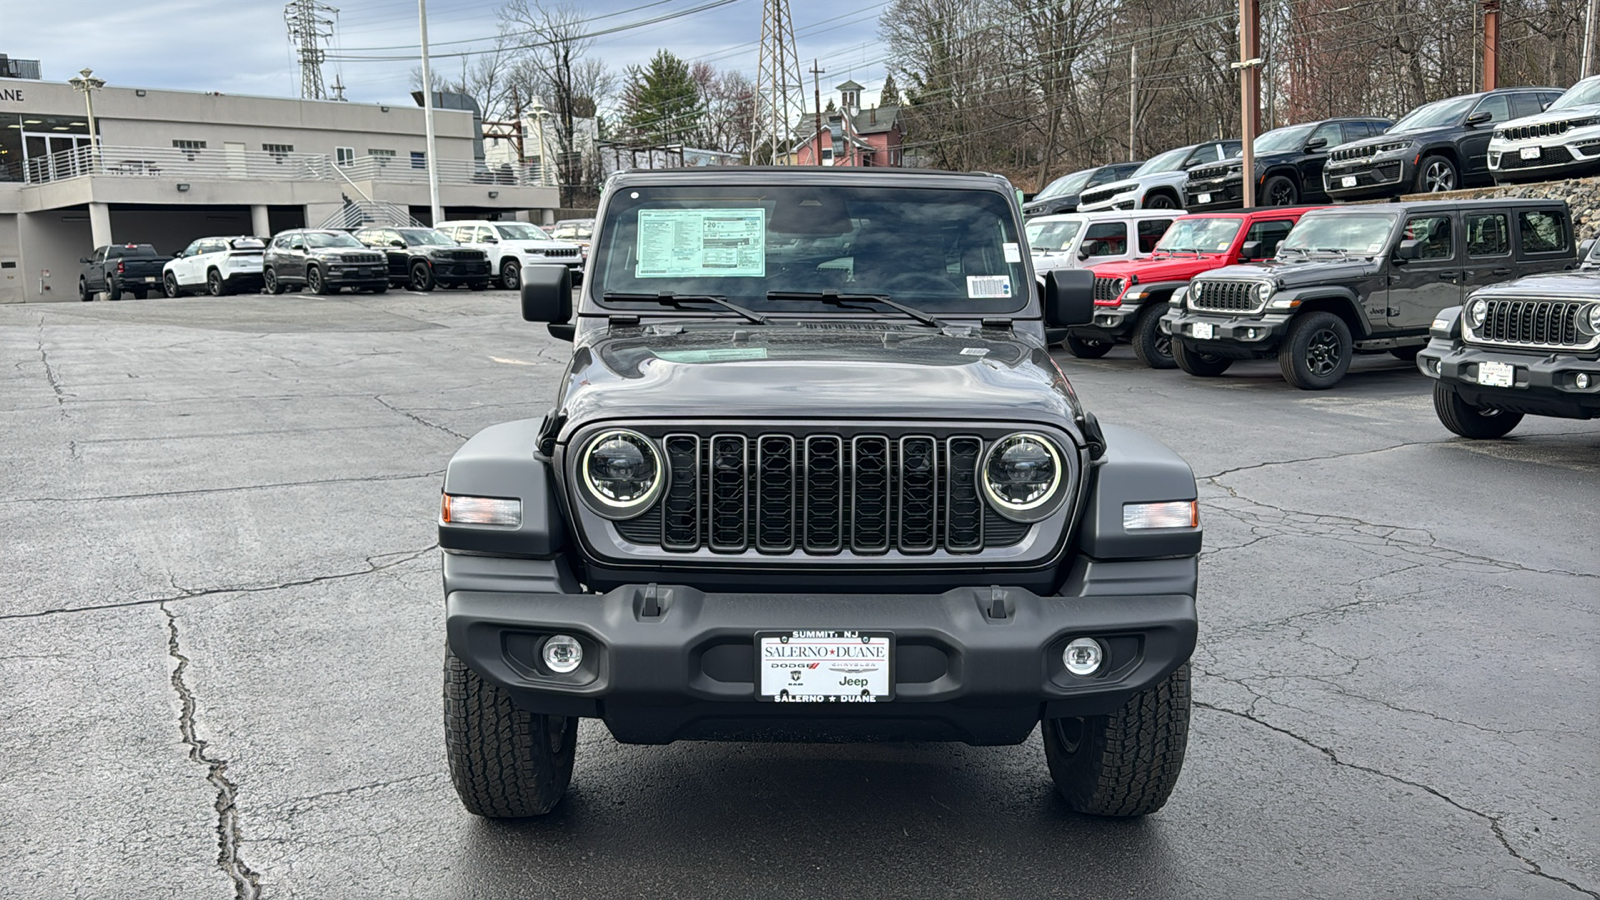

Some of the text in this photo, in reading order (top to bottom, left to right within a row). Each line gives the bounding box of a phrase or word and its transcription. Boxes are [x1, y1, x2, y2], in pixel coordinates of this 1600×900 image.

[843, 630, 859, 638] NJ
[765, 646, 885, 658] SALERNO DUANE
[839, 676, 869, 688] Jeep
[774, 695, 877, 703] SALERNO DUANE
